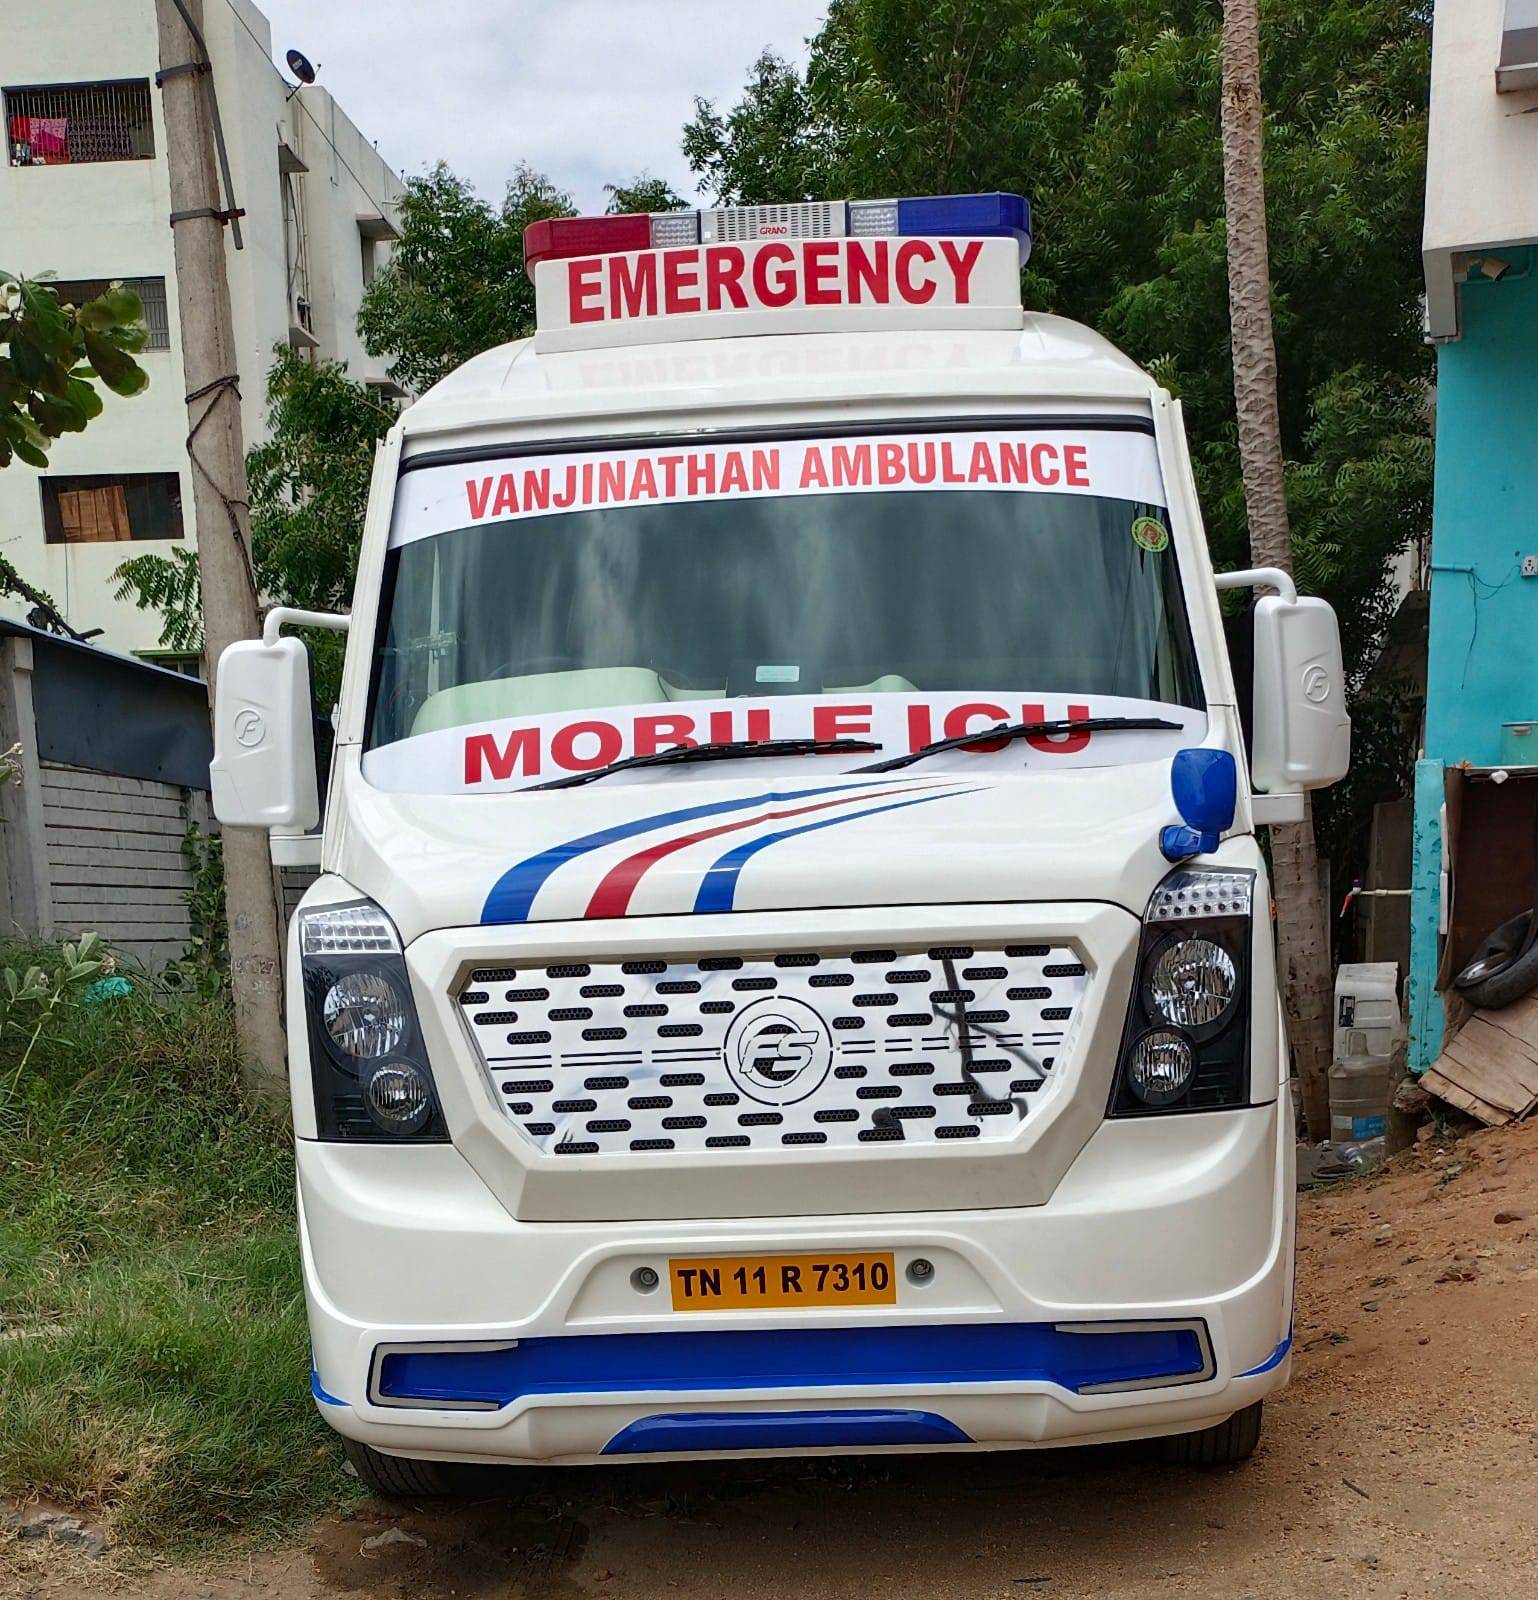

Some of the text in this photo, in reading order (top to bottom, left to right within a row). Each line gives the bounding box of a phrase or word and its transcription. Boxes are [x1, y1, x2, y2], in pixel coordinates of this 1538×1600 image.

[760, 226, 788, 235] GRAND
[567, 240, 983, 324] EMERGENCY
[466, 441, 1090, 519] VANJINATHAN AMBULANCE
[907, 703, 1091, 754] ICU
[676, 1262, 890, 1297] TN 11 R 7310
